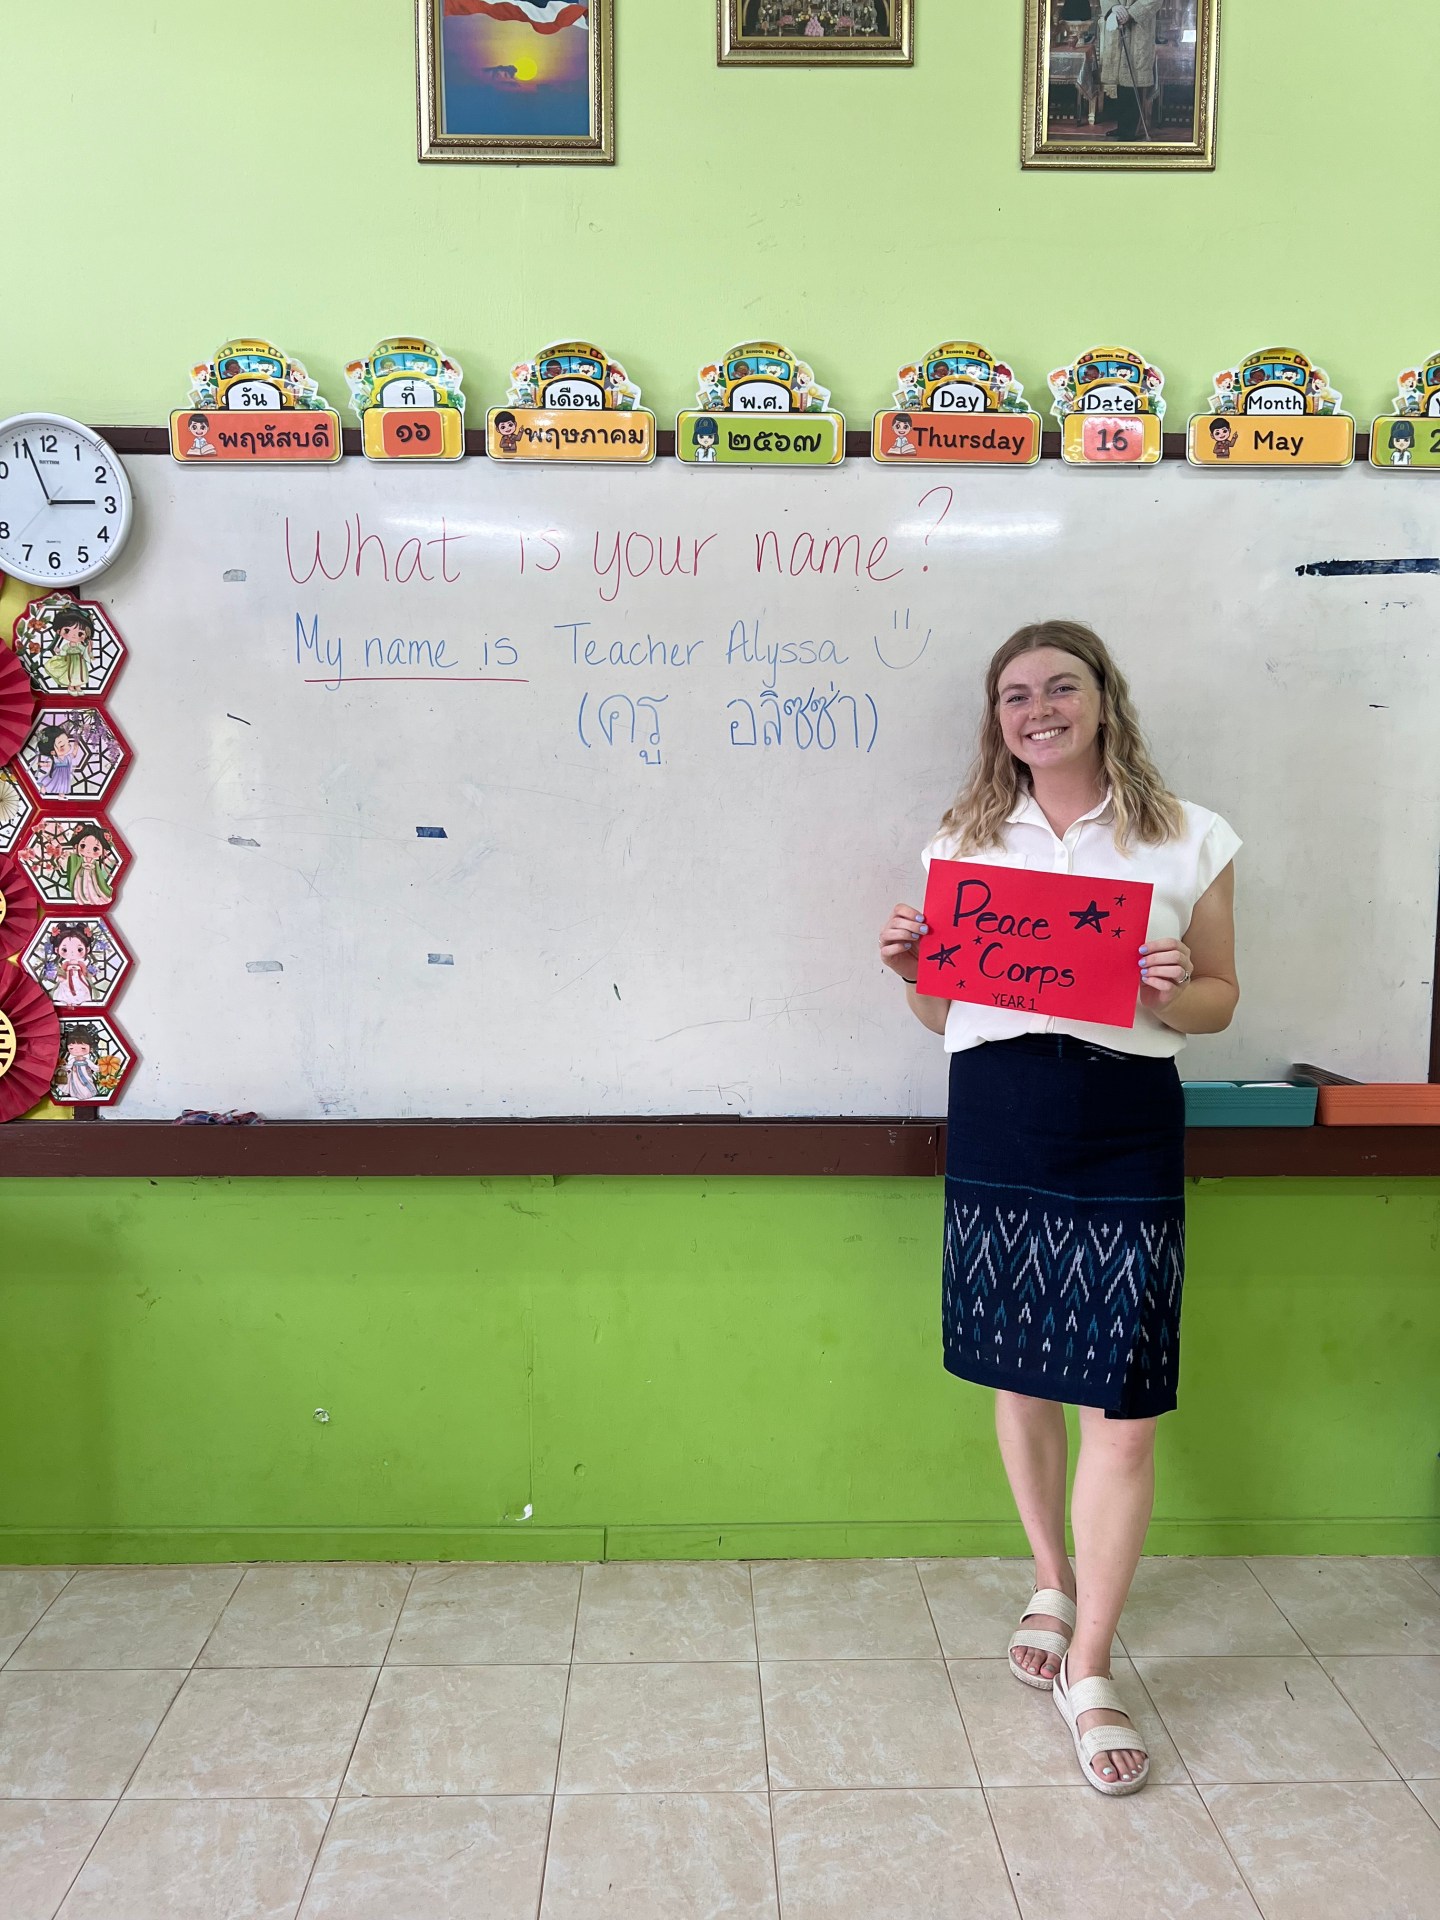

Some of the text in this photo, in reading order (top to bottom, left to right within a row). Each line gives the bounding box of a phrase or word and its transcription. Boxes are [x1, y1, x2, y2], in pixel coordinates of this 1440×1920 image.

[241, 388, 268, 406] วัน
[400, 381, 416, 405] ที่
[549, 386, 601, 407] เดือน
[740, 395, 784, 409] พ.ศ.
[940, 390, 979, 412] Day
[1086, 393, 1134, 412] Date
[1248, 395, 1303, 411] Month
[218, 423, 329, 454] พฤหัสบดี
[396, 422, 431, 443] ๑๖
[524, 427, 644, 449] พฤษภาคม
[727, 429, 822, 453] ๒๕๖๗
[913, 426, 1025, 455] Thursday
[1096, 428, 1128, 451] 16
[1253, 430, 1304, 456] May
[40, 435, 58, 453] 12
[74, 444, 81, 461] 1
[95, 466, 107, 483] 2
[104, 496, 117, 514] 3
[97, 526, 110, 543] 4
[285, 486, 953, 601] What is your name?
[22, 544, 33, 561] 7
[49, 552, 61, 569] 6
[77, 546, 89, 563] 5
[296, 612, 849, 691] My name is Teacher Alyssa
[952, 879, 1052, 941] Peace
[978, 942, 1076, 994] Corps
[991, 992, 1039, 1012] YEAR 1
